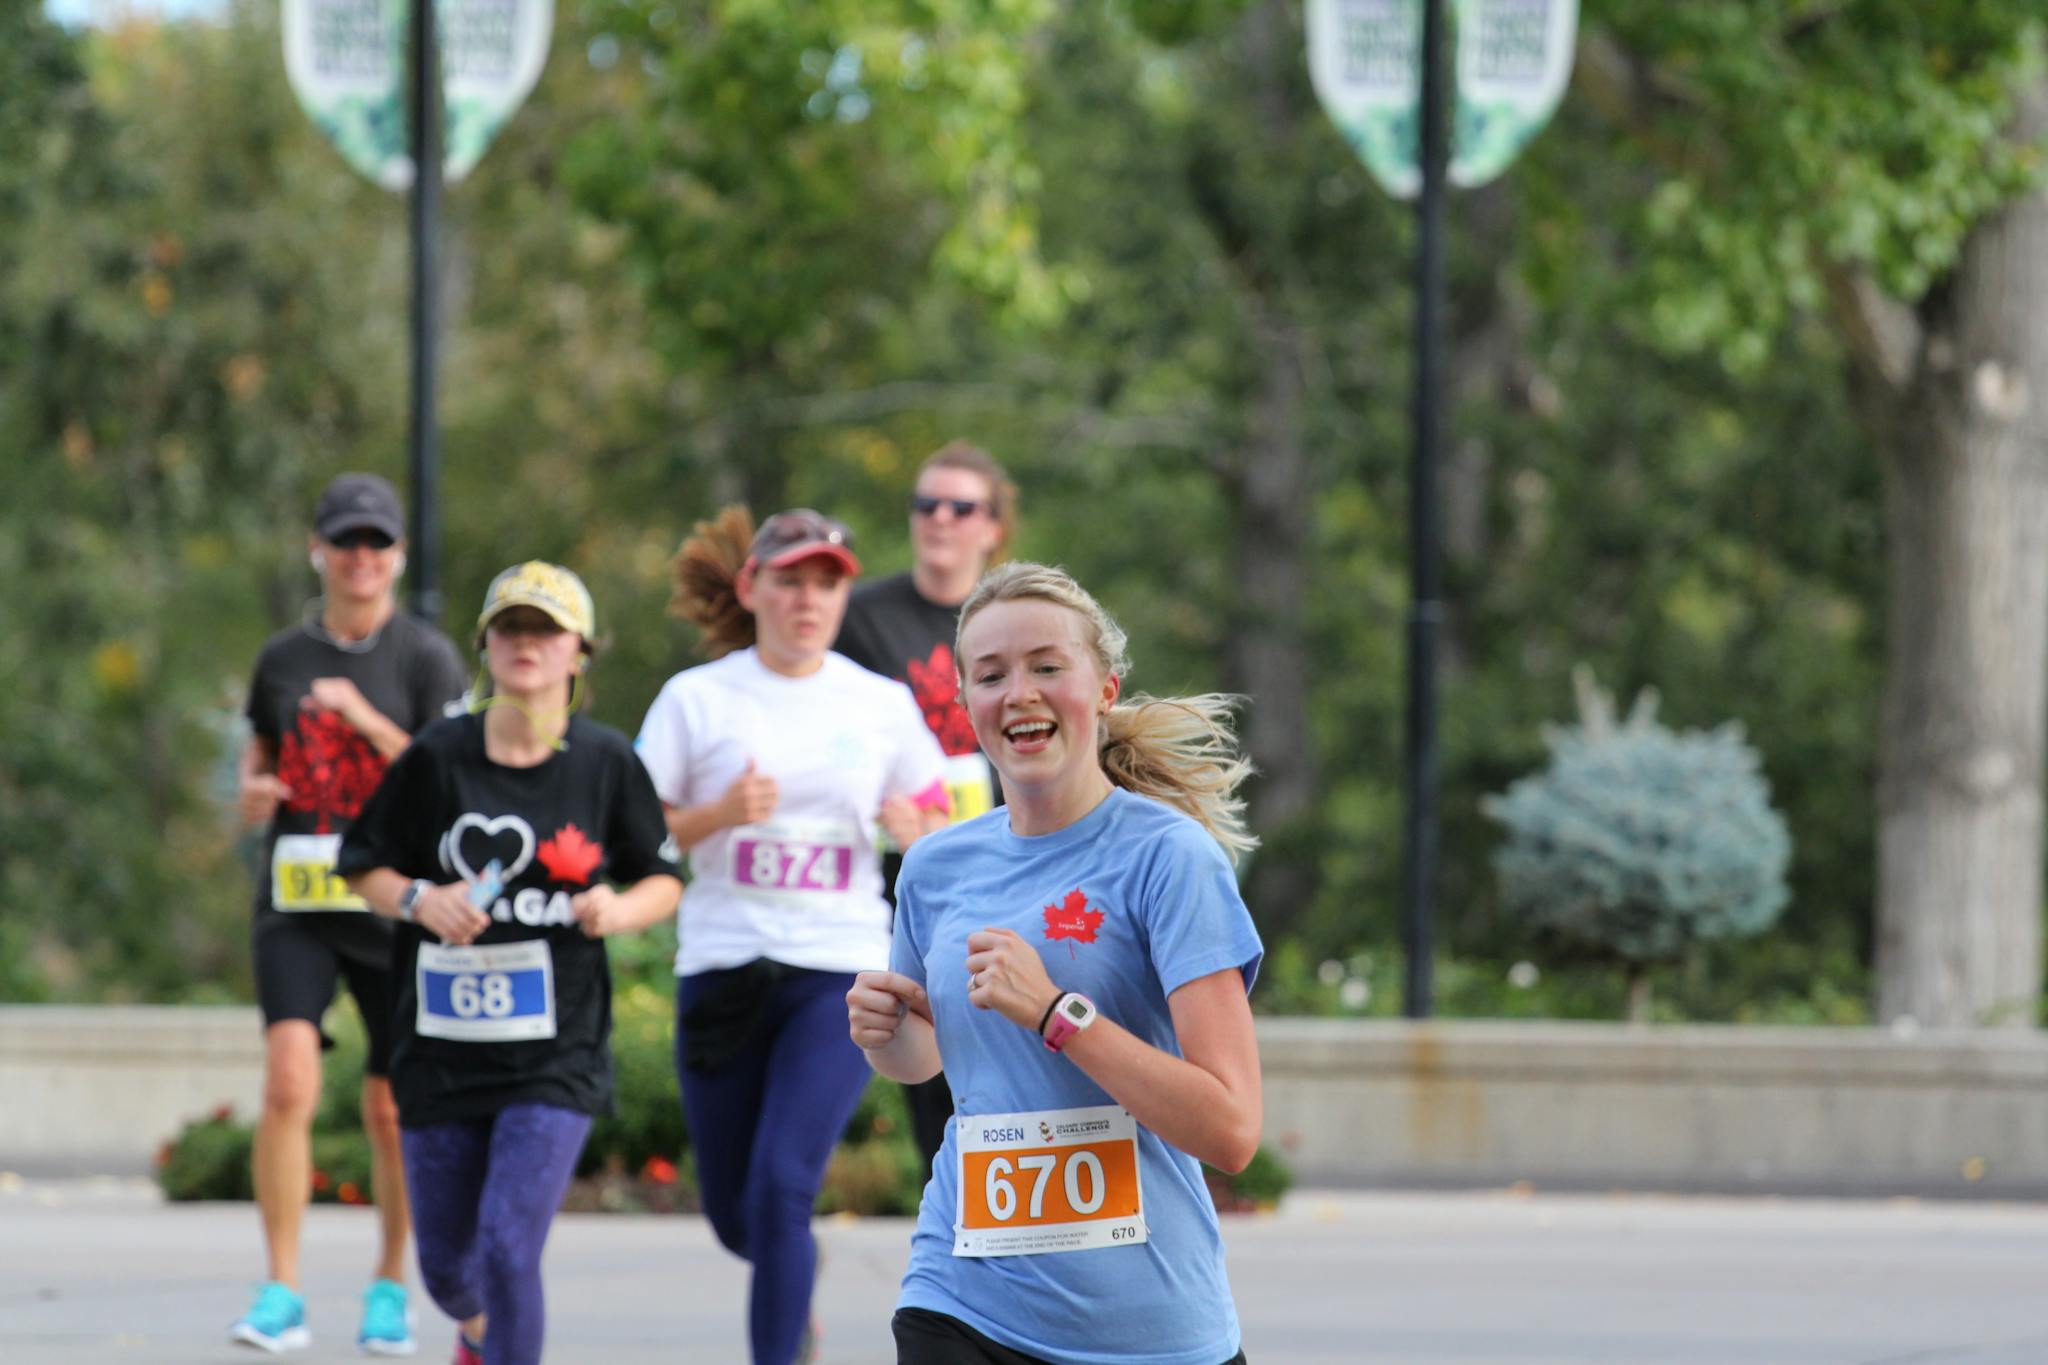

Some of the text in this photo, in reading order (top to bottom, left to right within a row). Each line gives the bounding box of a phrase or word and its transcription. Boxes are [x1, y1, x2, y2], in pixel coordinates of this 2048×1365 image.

[751, 843, 840, 889] 874
[449, 973, 515, 1019] 68
[983, 1127, 1024, 1143] ROSEN
[1056, 1124, 1110, 1135] CHALLENGE
[985, 1150, 1106, 1221] 670
[1111, 1226, 1136, 1240] 670
